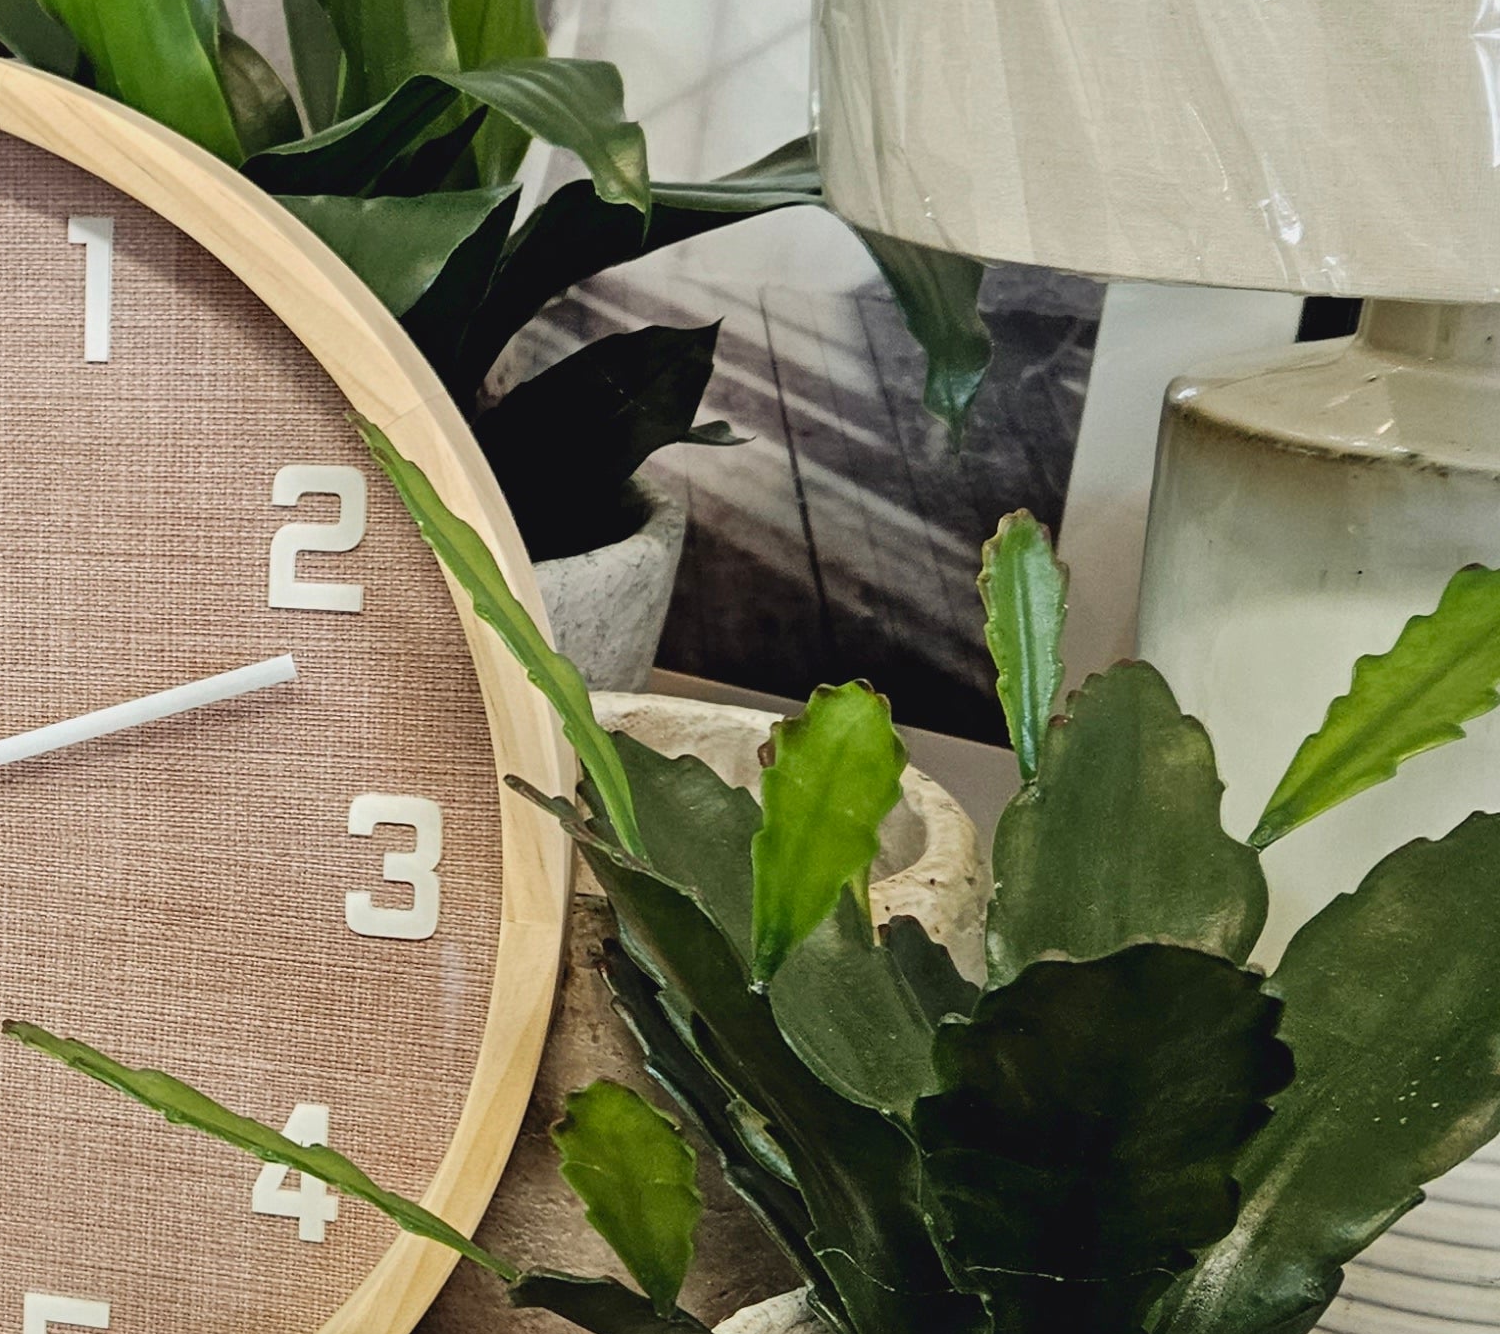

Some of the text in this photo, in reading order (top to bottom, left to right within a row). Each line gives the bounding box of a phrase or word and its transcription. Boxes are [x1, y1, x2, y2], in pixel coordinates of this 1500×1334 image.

[67, 217, 115, 363] 1
[268, 464, 368, 613] 2
[345, 793, 443, 941] 3
[251, 1103, 339, 1243] 4
